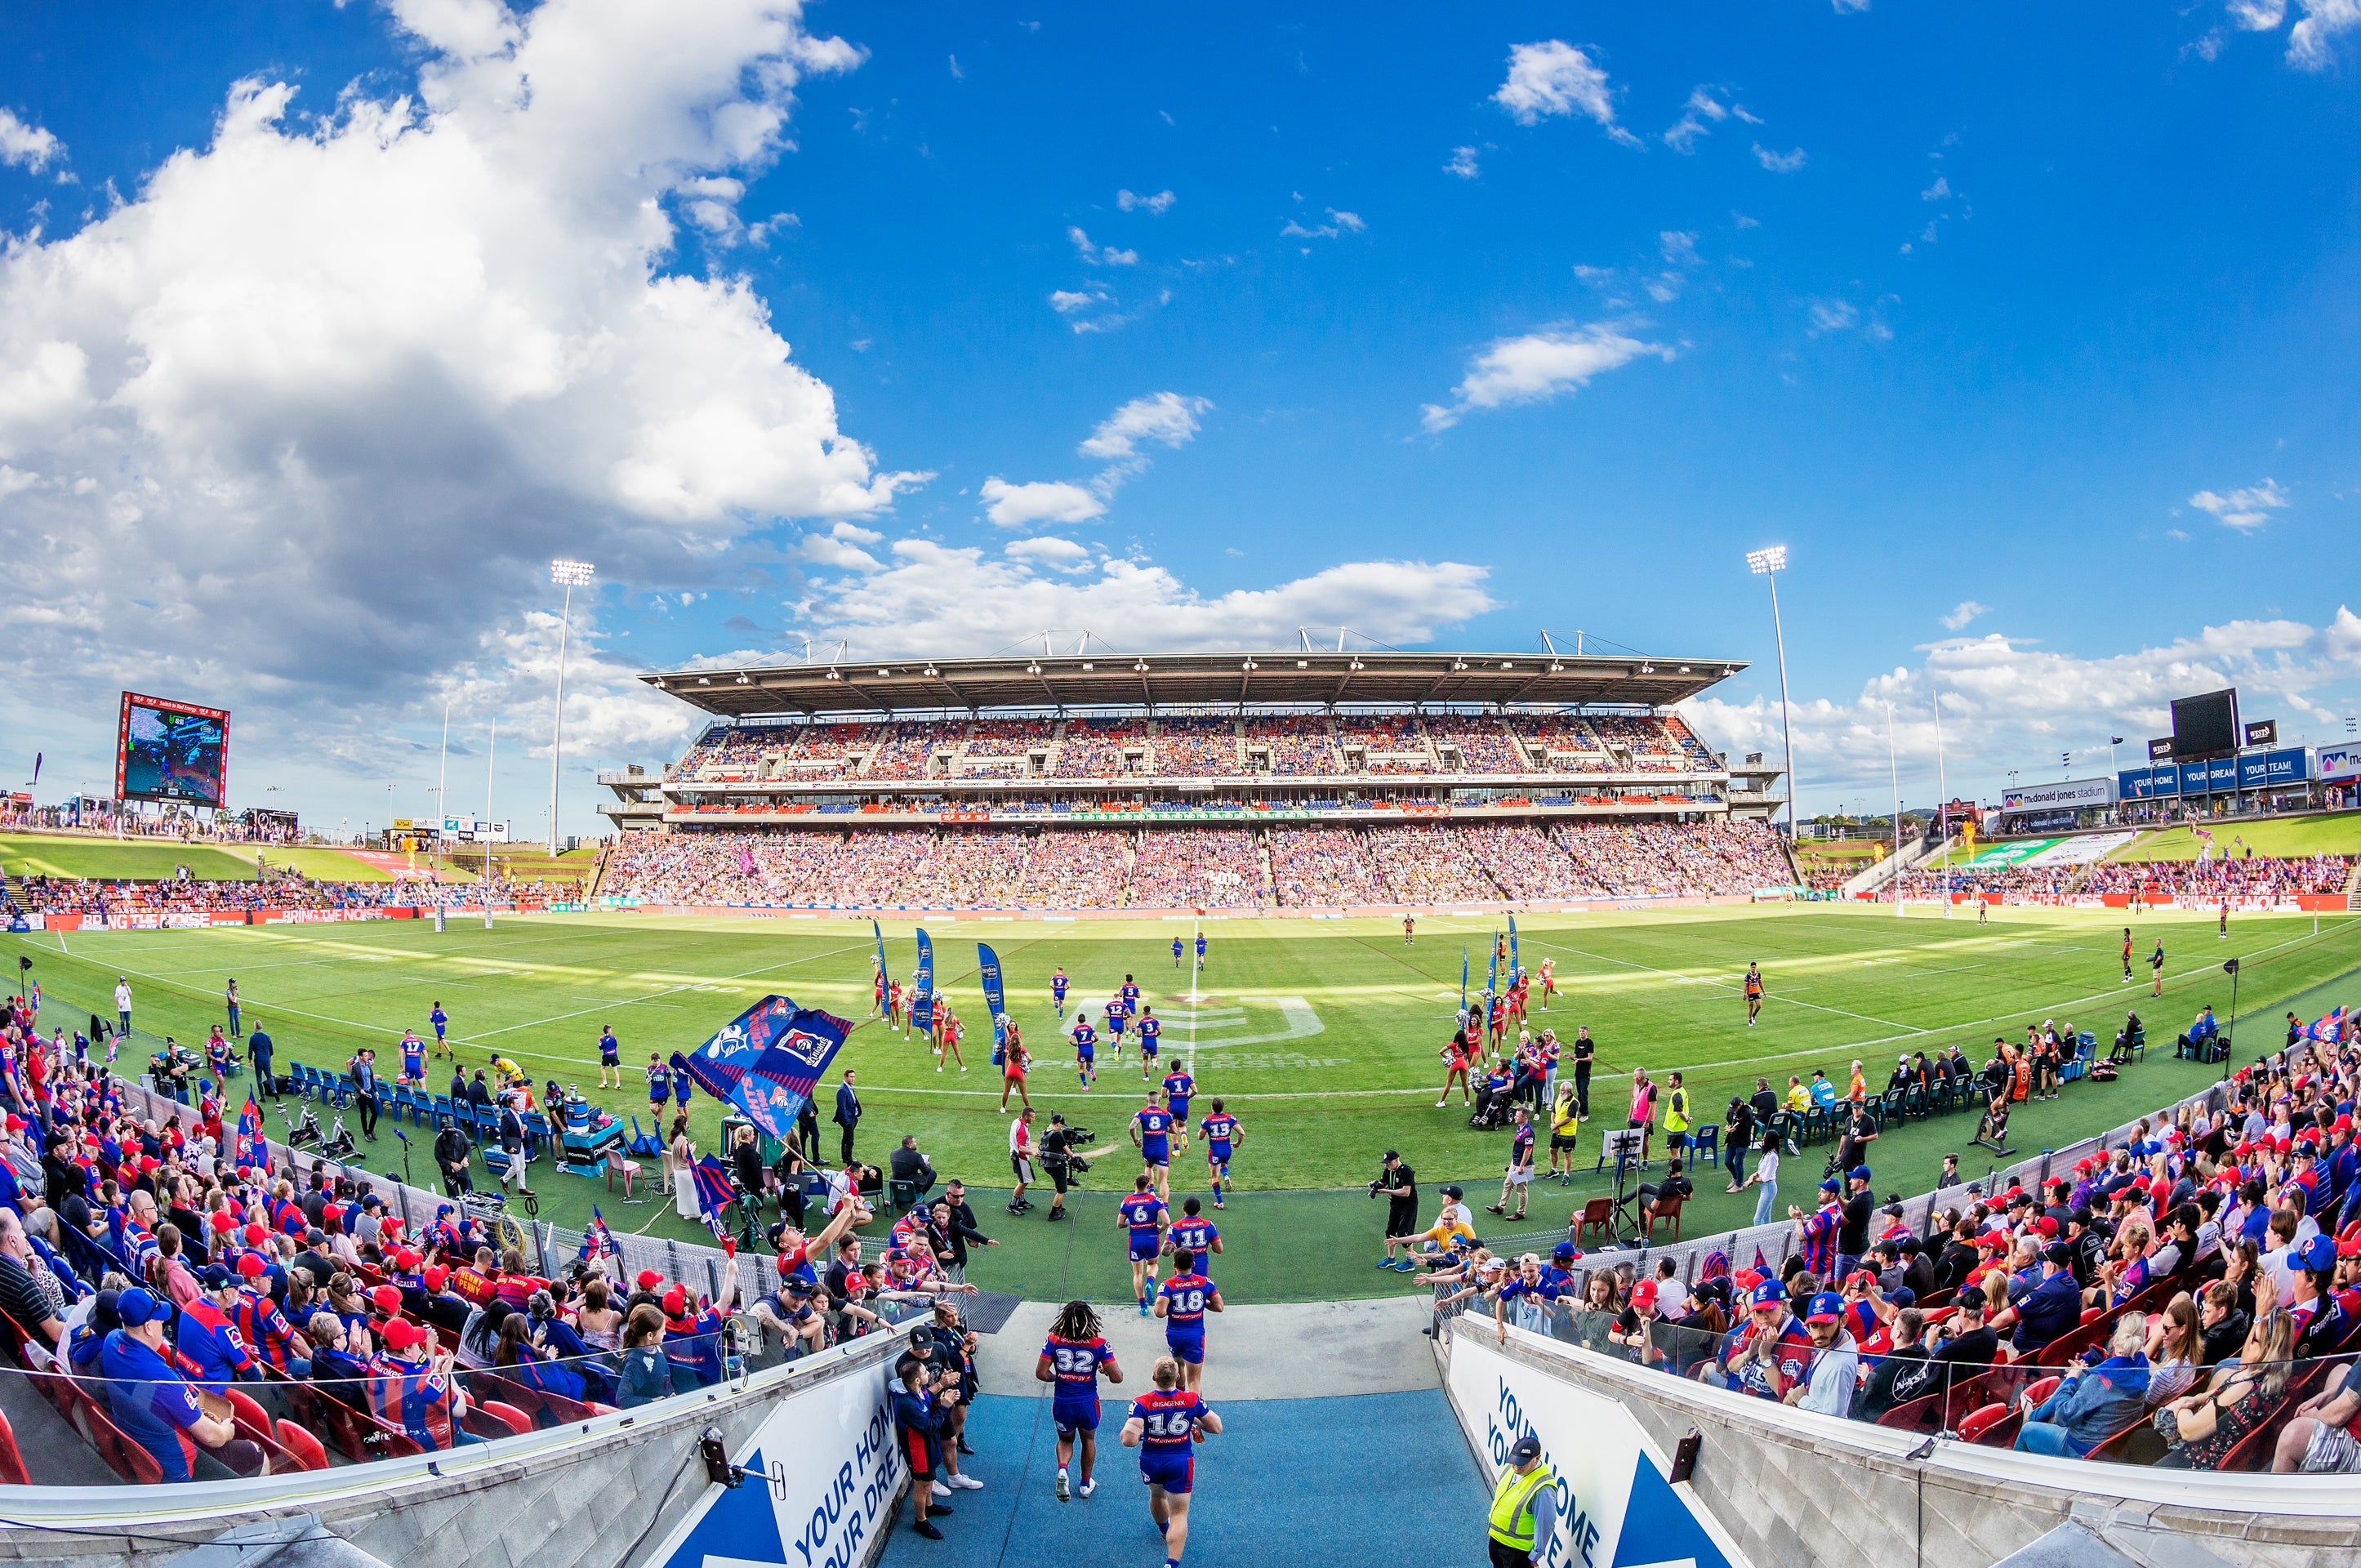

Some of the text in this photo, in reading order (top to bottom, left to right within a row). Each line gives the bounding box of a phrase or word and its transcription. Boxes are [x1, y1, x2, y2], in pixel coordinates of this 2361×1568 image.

[159, 700, 172, 708] Switch
[2133, 760, 2292, 788] YOUR HOME YOUR DREAM YOUR TEAM!
[2057, 790, 2075, 802] jones
[2077, 786, 2105, 798] stadium
[2002, 893, 2103, 906] BRING THE NOISE
[2173, 896, 2211, 909] BRING
[2212, 896, 2238, 909] THE
[283, 908, 383, 923] BRING THE NOISE
[1110, 1005, 1122, 1014] 12
[1146, 1022, 1153, 1032] 3
[1080, 1031, 1088, 1040] 7
[406, 1041, 420, 1052] 17
[653, 1074, 665, 1082] nib
[2021, 1068, 2028, 1083] 8
[1174, 1080, 1183, 1093] 1
[1148, 1116, 1160, 1130] 8
[1209, 1122, 1231, 1137] 13
[1134, 1205, 1147, 1223] 6
[1181, 1228, 1207, 1248] 11
[459, 1270, 485, 1288] HENNY
[508, 1276, 528, 1288] Penny
[458, 1278, 481, 1296] PENNY
[1172, 1290, 1204, 1312] 18
[915, 1334, 924, 1342] LA
[1056, 1348, 1094, 1372] 32
[1896, 1370, 1927, 1390] NASA
[1147, 1410, 1190, 1436] 16
[795, 1397, 895, 1568] YOUR HOM
